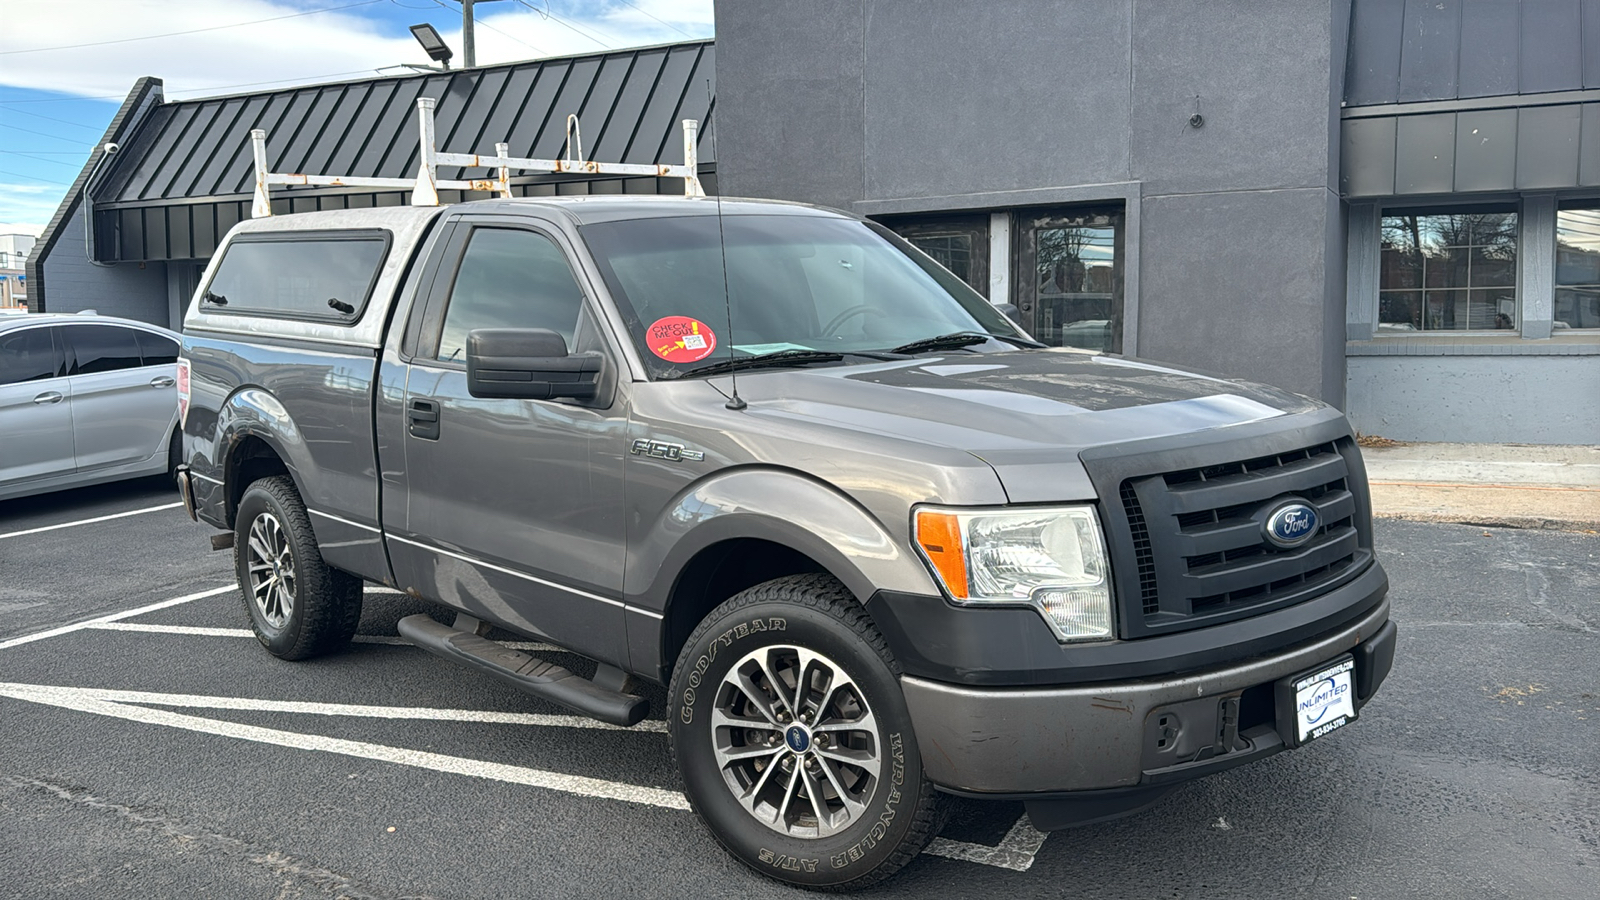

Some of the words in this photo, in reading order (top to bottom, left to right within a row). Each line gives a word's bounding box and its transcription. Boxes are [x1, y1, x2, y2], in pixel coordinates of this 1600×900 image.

[652, 322, 688, 333] CHECK
[655, 331, 671, 339] ME
[1284, 511, 1309, 534] Ford
[681, 618, 787, 725] GOODYEAR
[1298, 683, 1348, 712] UNLIMITED
[831, 733, 905, 869] WRANGLER
[758, 848, 820, 873] AT/S
